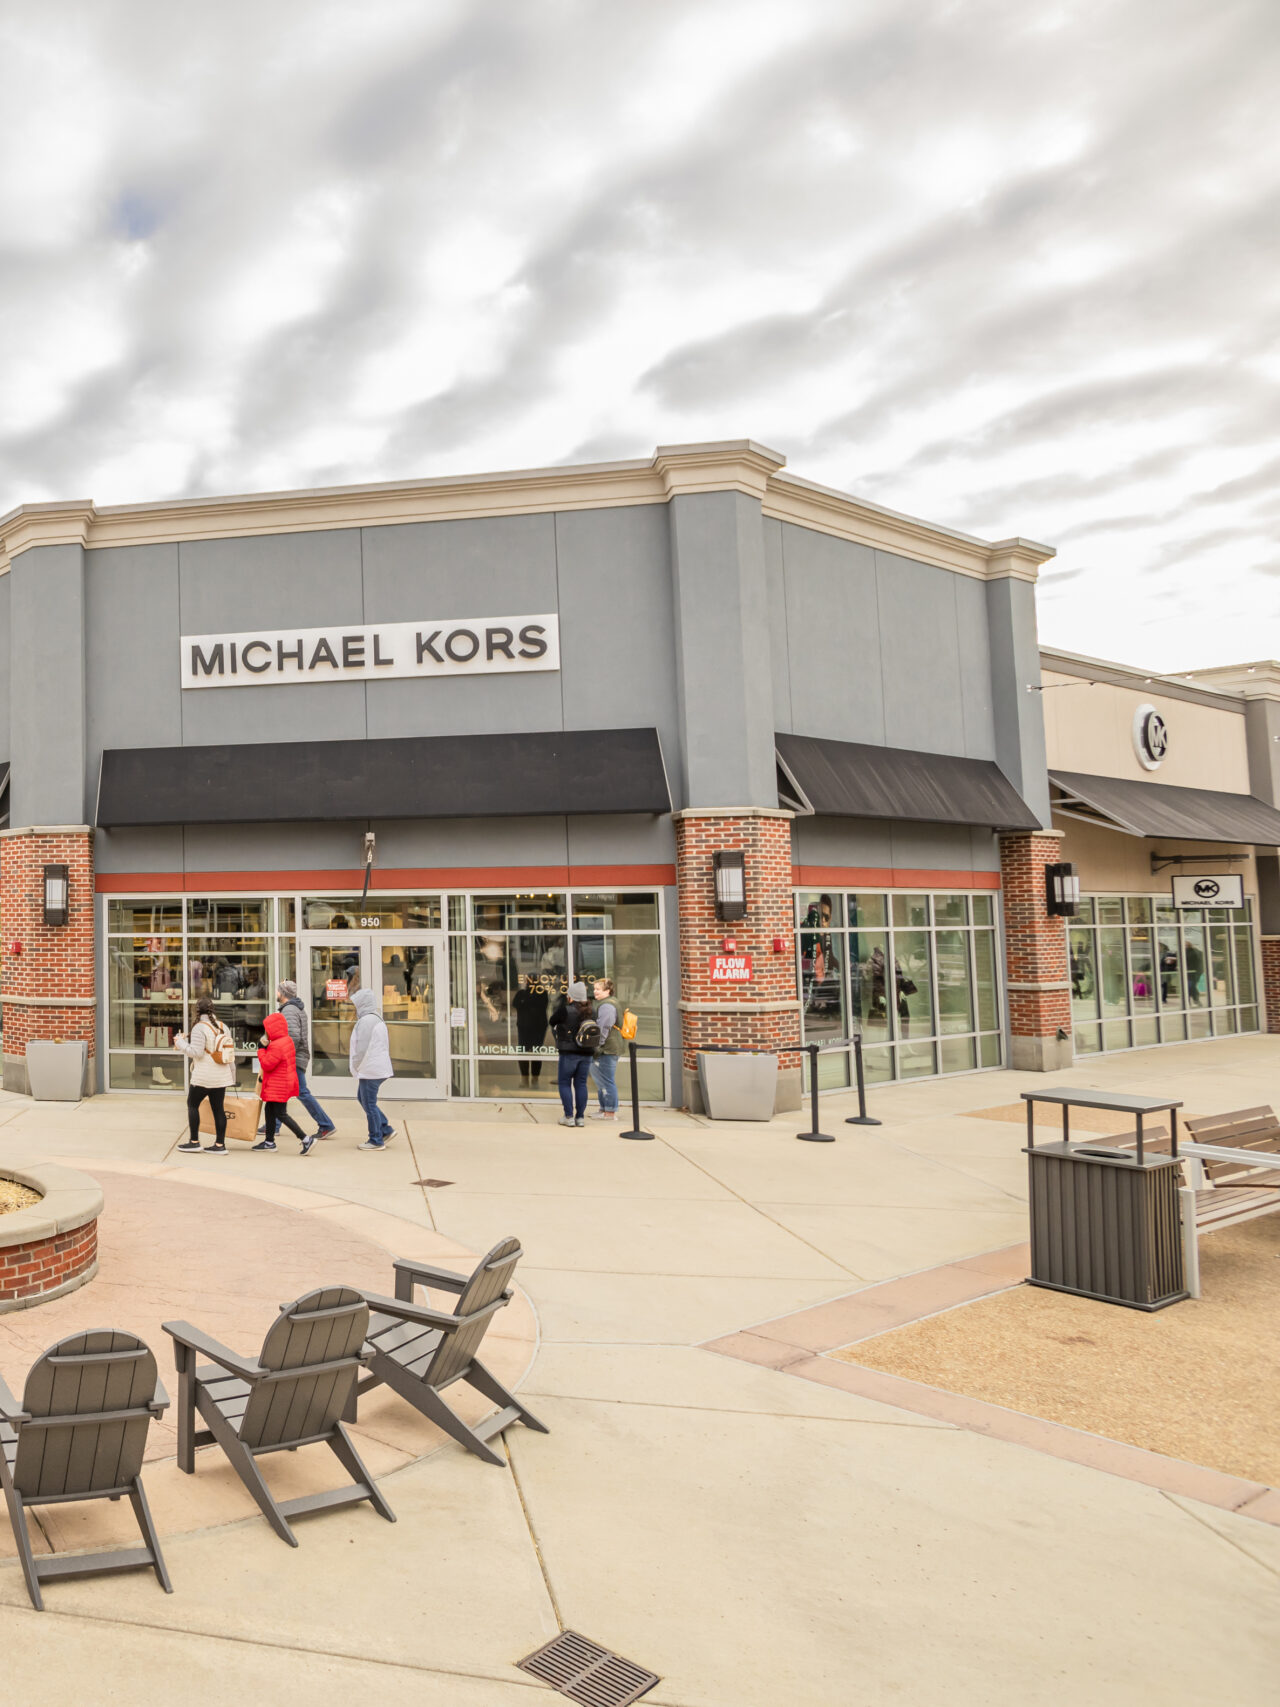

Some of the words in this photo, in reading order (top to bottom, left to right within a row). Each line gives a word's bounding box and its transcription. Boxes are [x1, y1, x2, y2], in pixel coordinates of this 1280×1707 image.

[191, 633, 394, 676] MICHAEL
[416, 624, 548, 665] KORS
[360, 917, 380, 927] 950
[715, 957, 746, 969] FLOW
[712, 968, 751, 979] ALARM
[518, 974, 557, 984] ENJOY
[528, 985, 556, 994] 70%
[479, 1045, 526, 1054] MICHAEL
